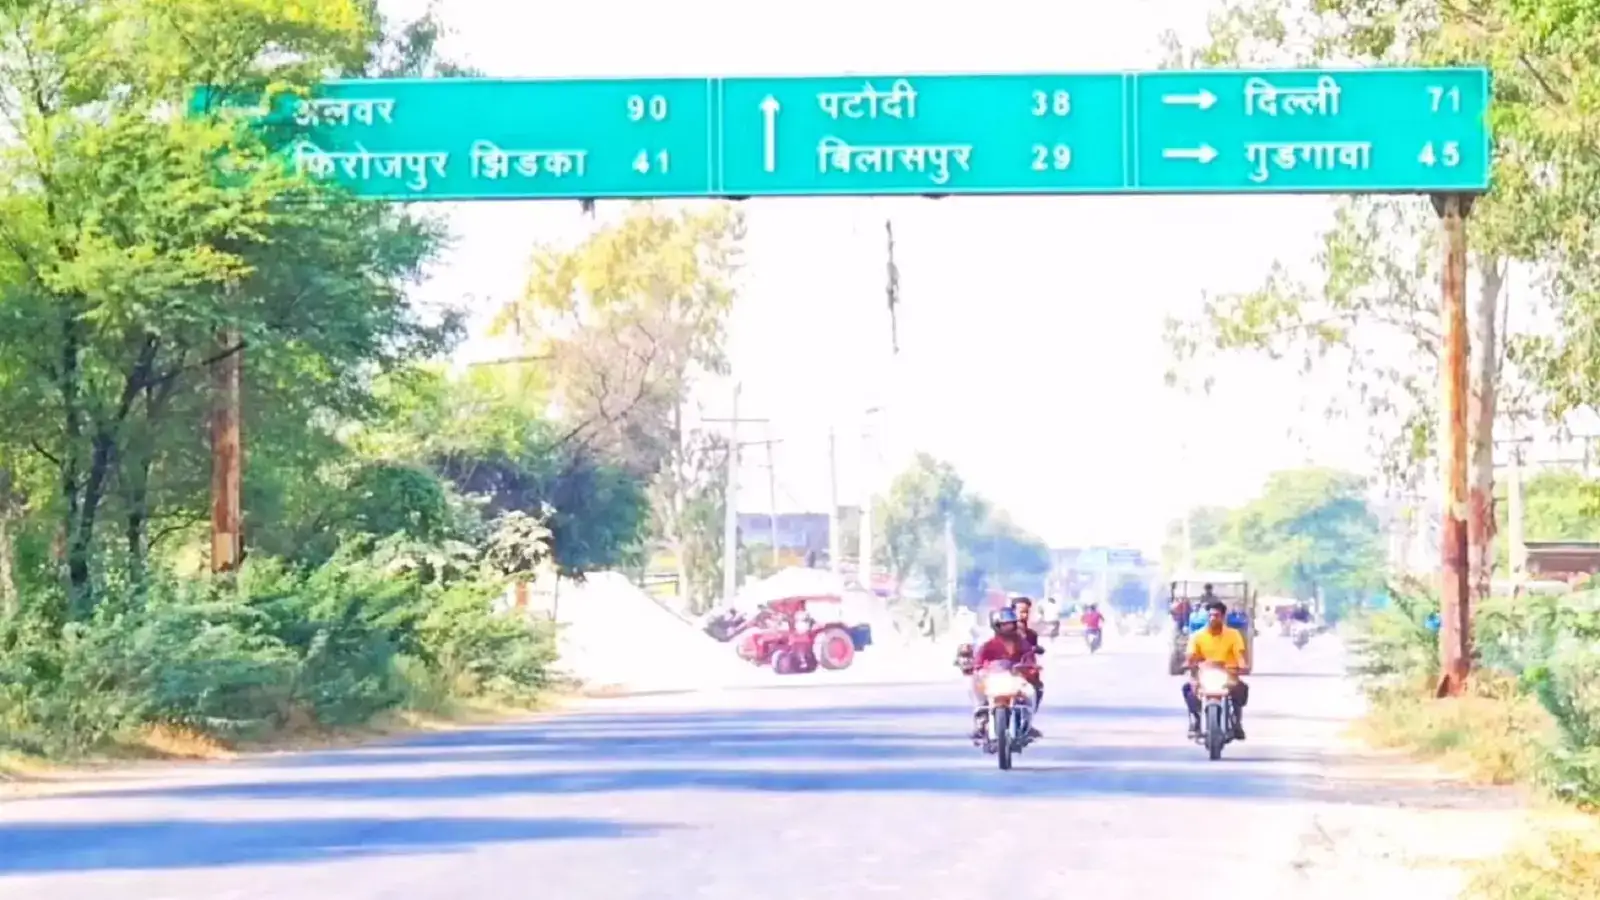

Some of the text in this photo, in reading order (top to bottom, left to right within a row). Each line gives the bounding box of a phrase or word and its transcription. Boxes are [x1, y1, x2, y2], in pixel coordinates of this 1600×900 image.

[293, 95, 668, 127] अलवर 90
[817, 79, 1071, 119] पटौदी 38
[1244, 76, 1461, 116] दिल्ली 71
[294, 141, 449, 192] फिरोजपुर
[632, 150, 670, 174] 41
[1030, 144, 1071, 171] 29
[1418, 141, 1461, 168] 45
